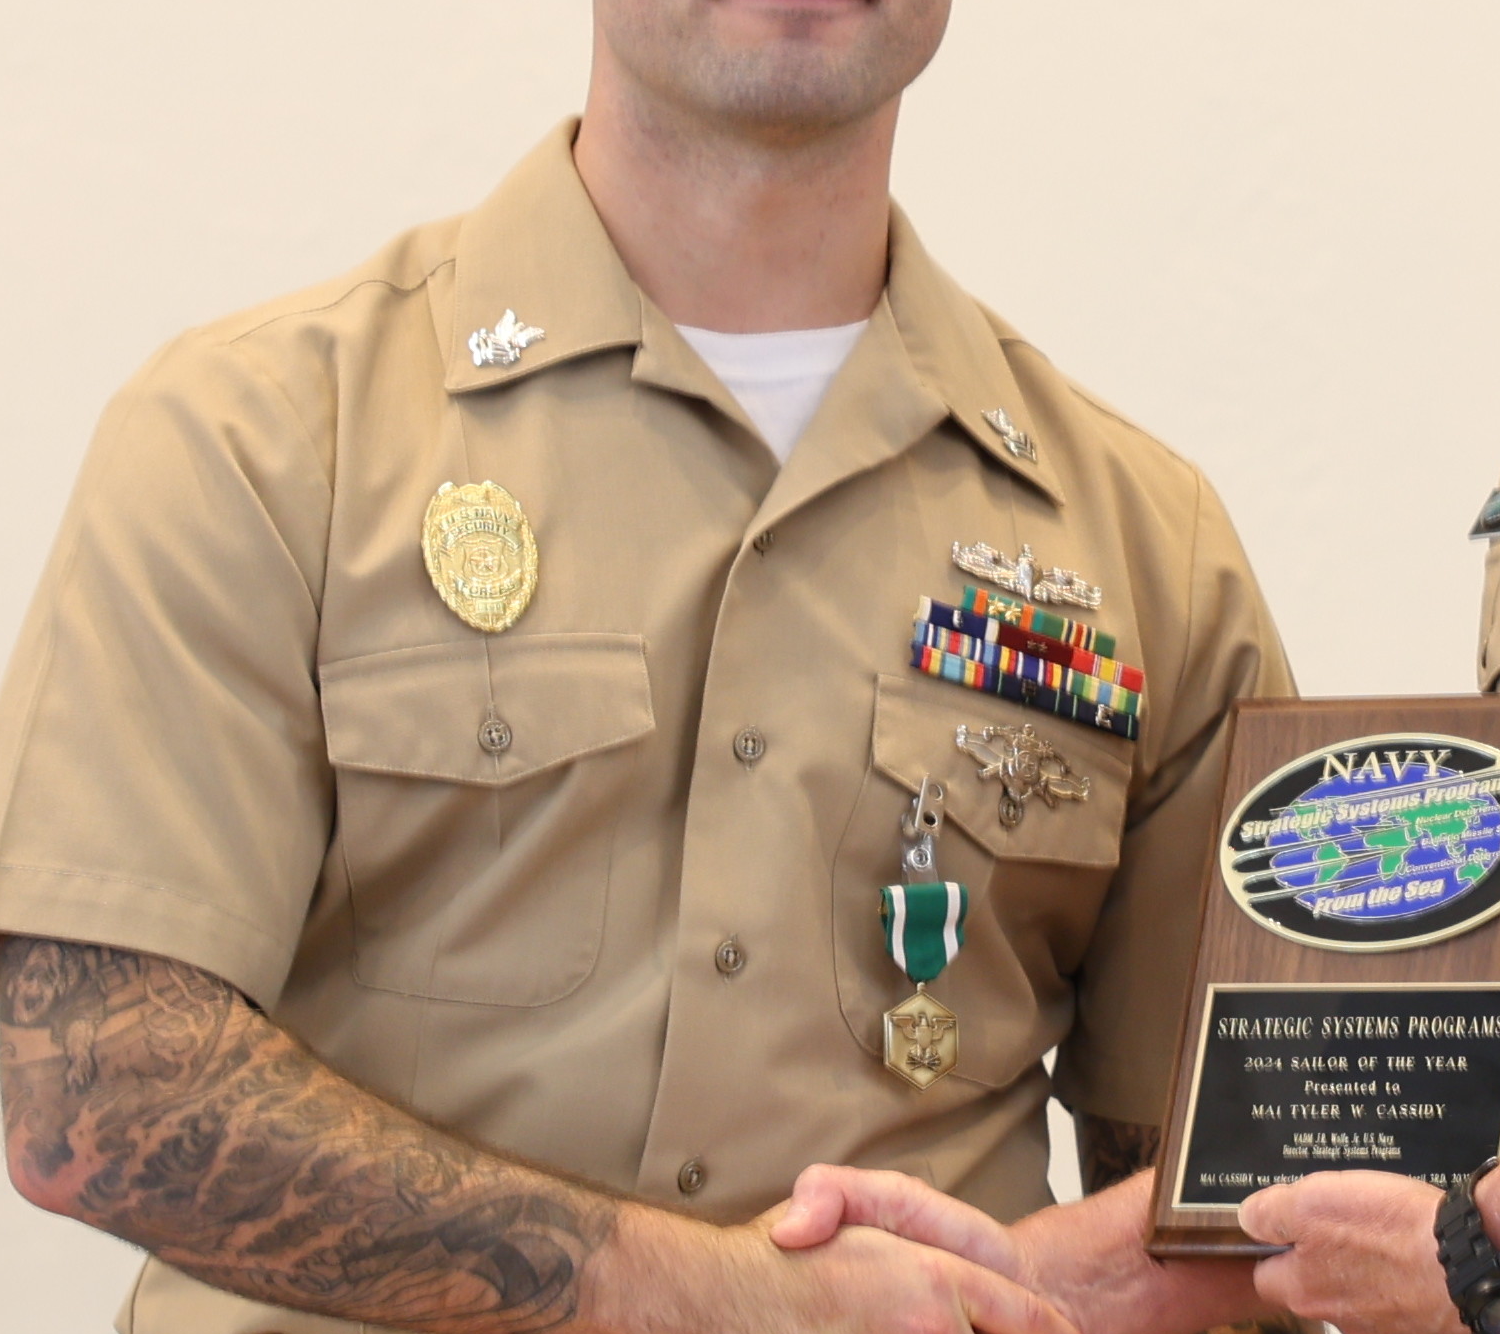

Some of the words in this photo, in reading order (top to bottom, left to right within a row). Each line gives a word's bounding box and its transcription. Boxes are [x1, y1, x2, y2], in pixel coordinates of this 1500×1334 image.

[1318, 749, 1451, 783] NAVY
[1241, 807, 1333, 840] Strategic
[1336, 793, 1421, 821] Systems
[1418, 812, 1452, 824] Nuclear
[1313, 892, 1366, 916] From
[1367, 884, 1403, 907] the
[1404, 879, 1445, 901] Sea
[1218, 1017, 1314, 1039] STRATEGIC
[1321, 1016, 1400, 1039] SYSTEMS
[1244, 1056, 1282, 1071] 2024
[1290, 1056, 1349, 1072] SAILOR
[1357, 1056, 1378, 1072] OF
[1386, 1056, 1416, 1072] THE
[1424, 1056, 1468, 1072] YEAR
[1304, 1080, 1377, 1095] Presented
[1385, 1081, 1402, 1096] to
[1290, 1104, 1340, 1119] TYLER
[1376, 1103, 1446, 1119] CASSIDY
[1293, 1132, 1313, 1145] VADM
[1378, 1132, 1394, 1146] Navy
[1312, 1144, 1340, 1160] Strategic
[1343, 1144, 1369, 1160] Systems
[1371, 1143, 1401, 1160] Programs
[1218, 1173, 1254, 1185] CASSIDY
[1257, 1175, 1271, 1185] was
